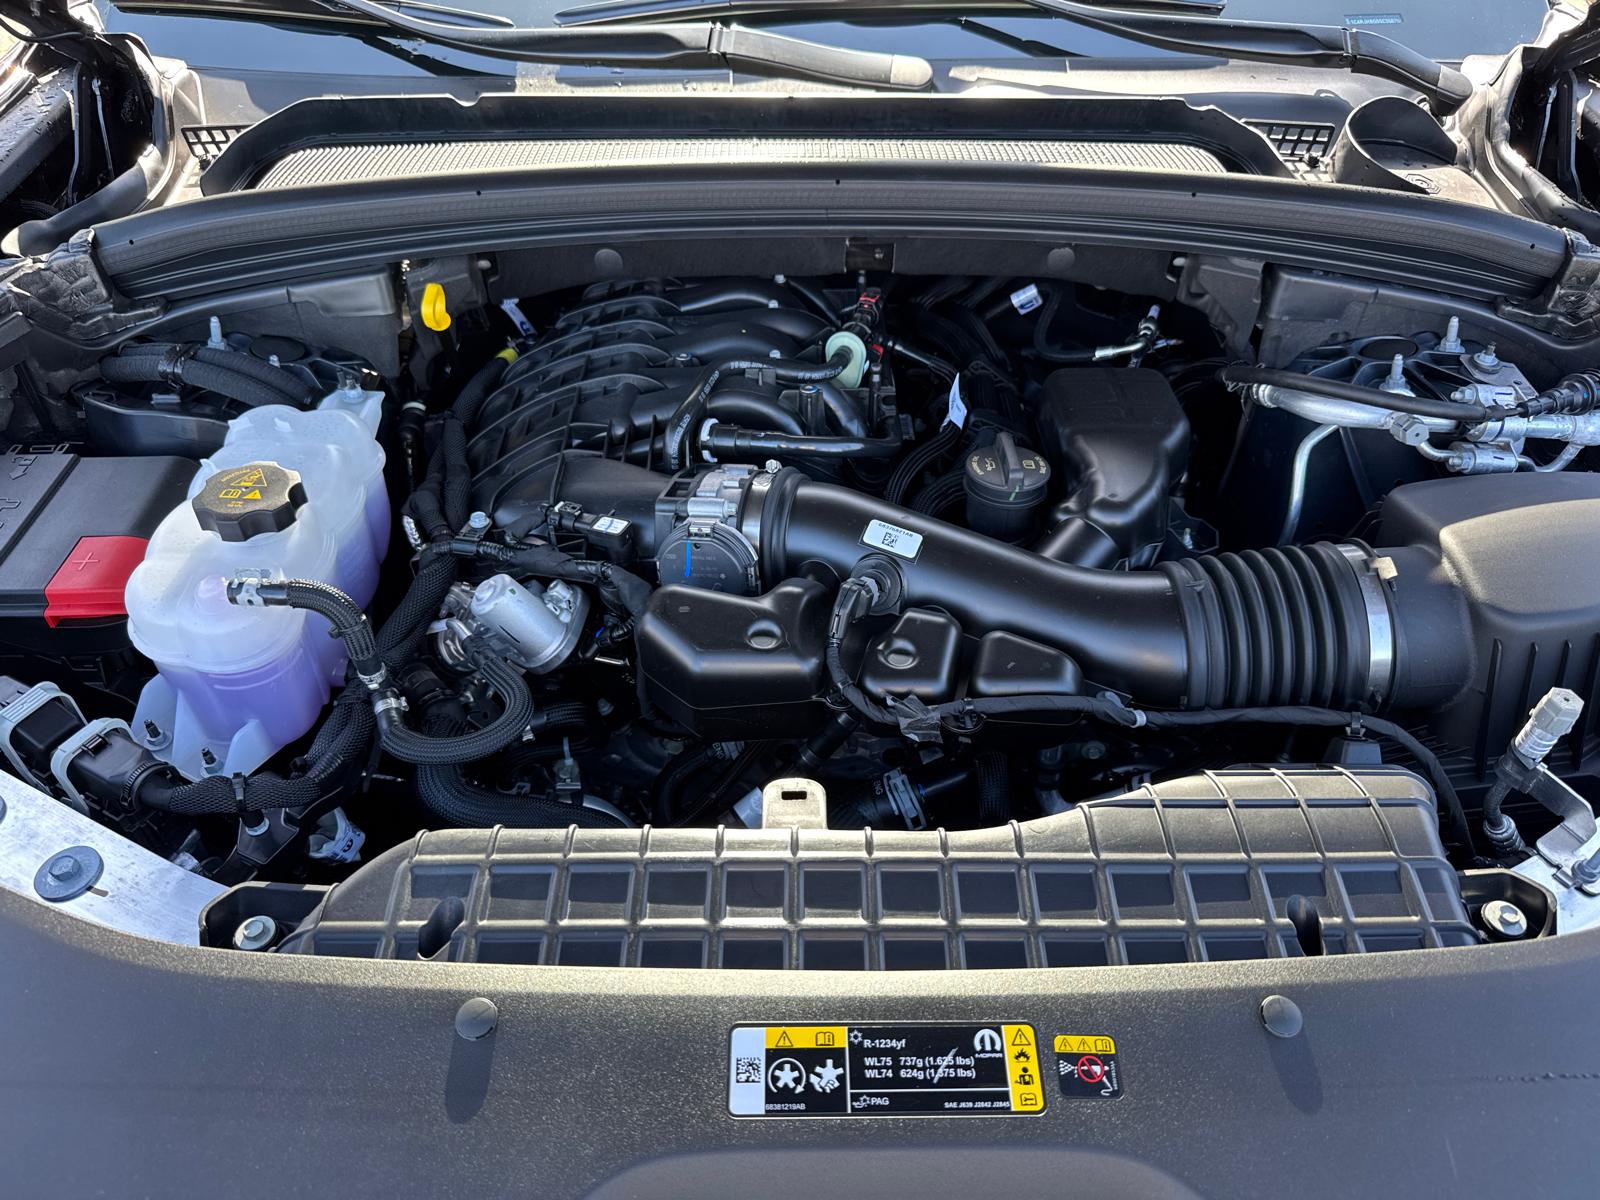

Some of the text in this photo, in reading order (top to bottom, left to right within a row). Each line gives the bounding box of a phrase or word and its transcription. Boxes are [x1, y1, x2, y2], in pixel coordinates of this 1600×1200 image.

[863, 1038, 906, 1050] R-1234yf
[864, 1056, 893, 1066] WL75
[899, 1056, 923, 1067] 737g
[955, 1055, 975, 1067] lbs)
[864, 1068, 893, 1078] WL74
[900, 1068, 924, 1079] 624g
[956, 1068, 976, 1079] lbs)
[870, 1096, 890, 1105] PAG
